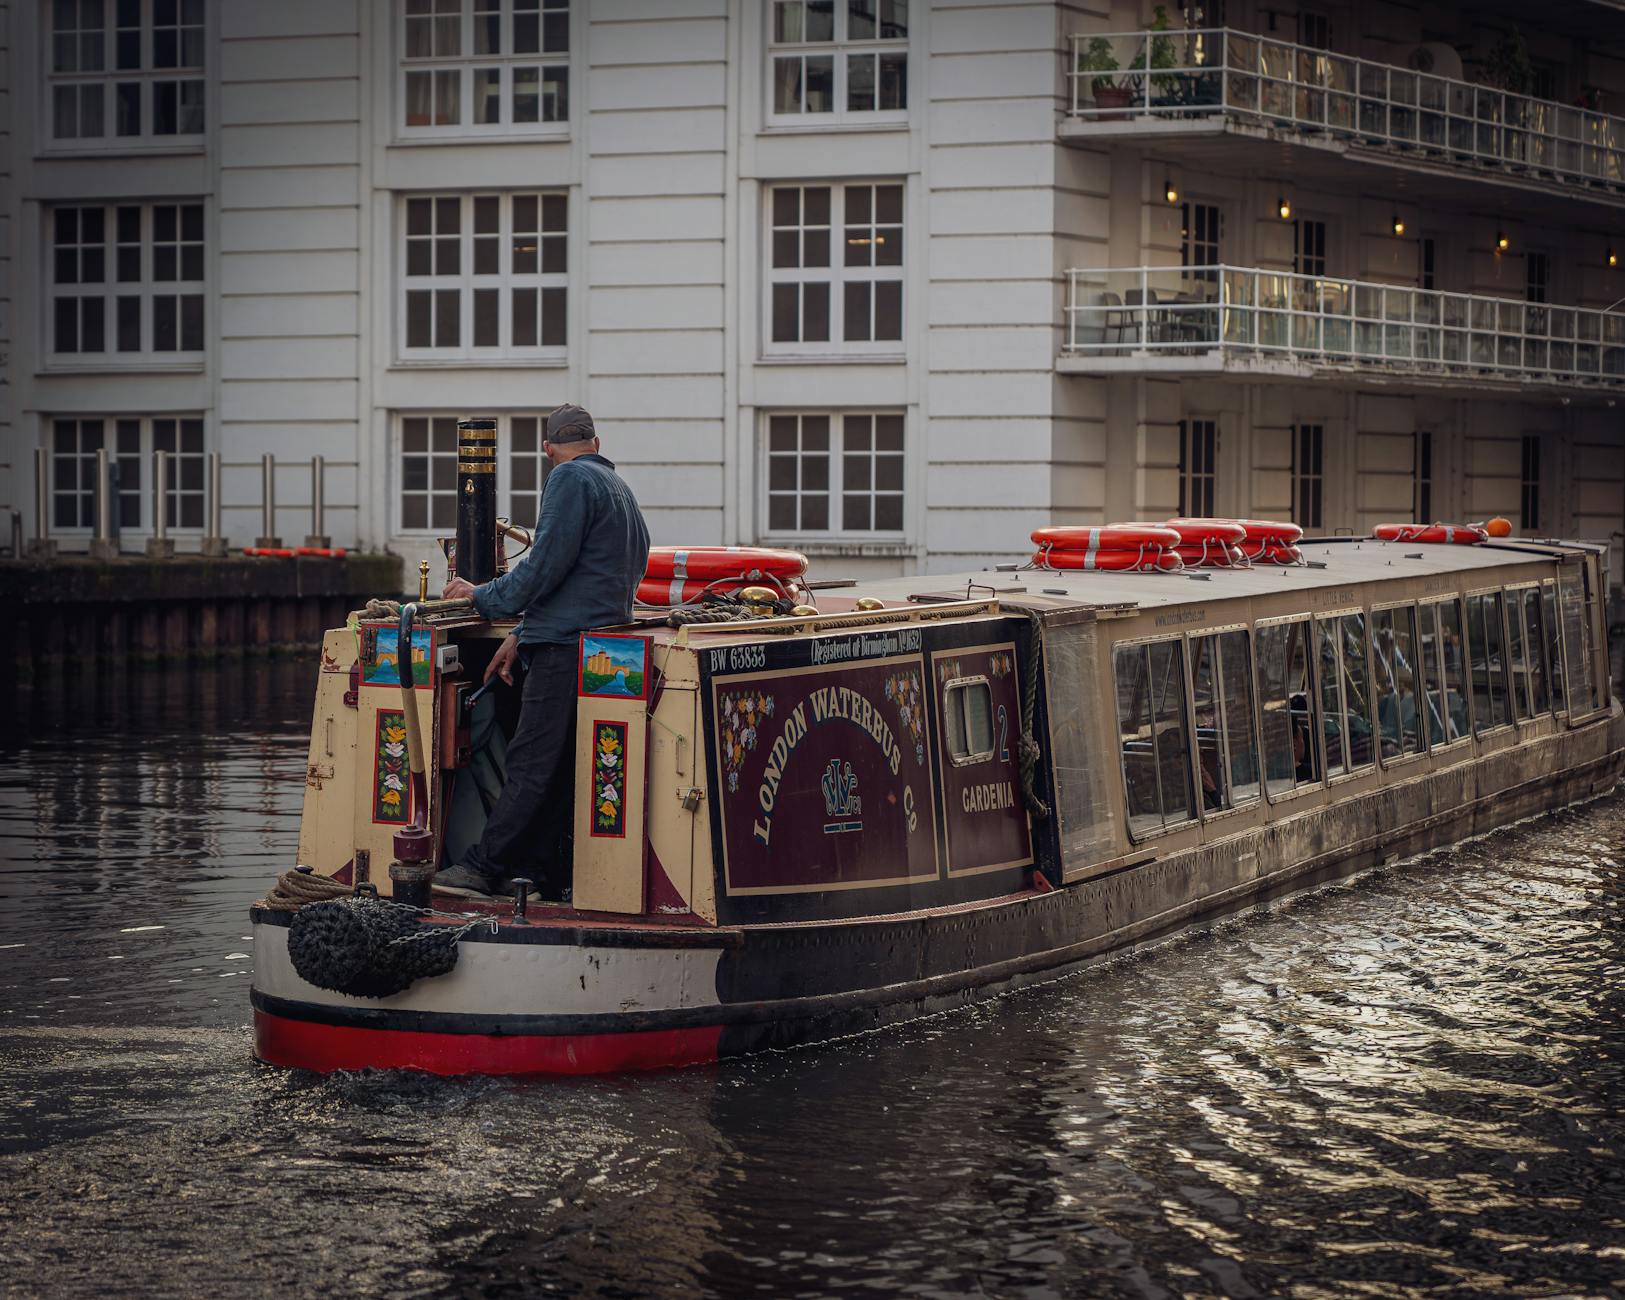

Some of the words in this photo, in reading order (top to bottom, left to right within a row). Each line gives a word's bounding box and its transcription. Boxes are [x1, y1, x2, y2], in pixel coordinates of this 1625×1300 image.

[710, 648, 728, 672] BW
[730, 646, 766, 670] 63833
[861, 633, 898, 657] Birmingham
[998, 704, 1010, 763] 2
[753, 702, 808, 846] LONDON
[810, 686, 901, 776] WATERBUS
[962, 781, 1015, 813] GARDENIA
